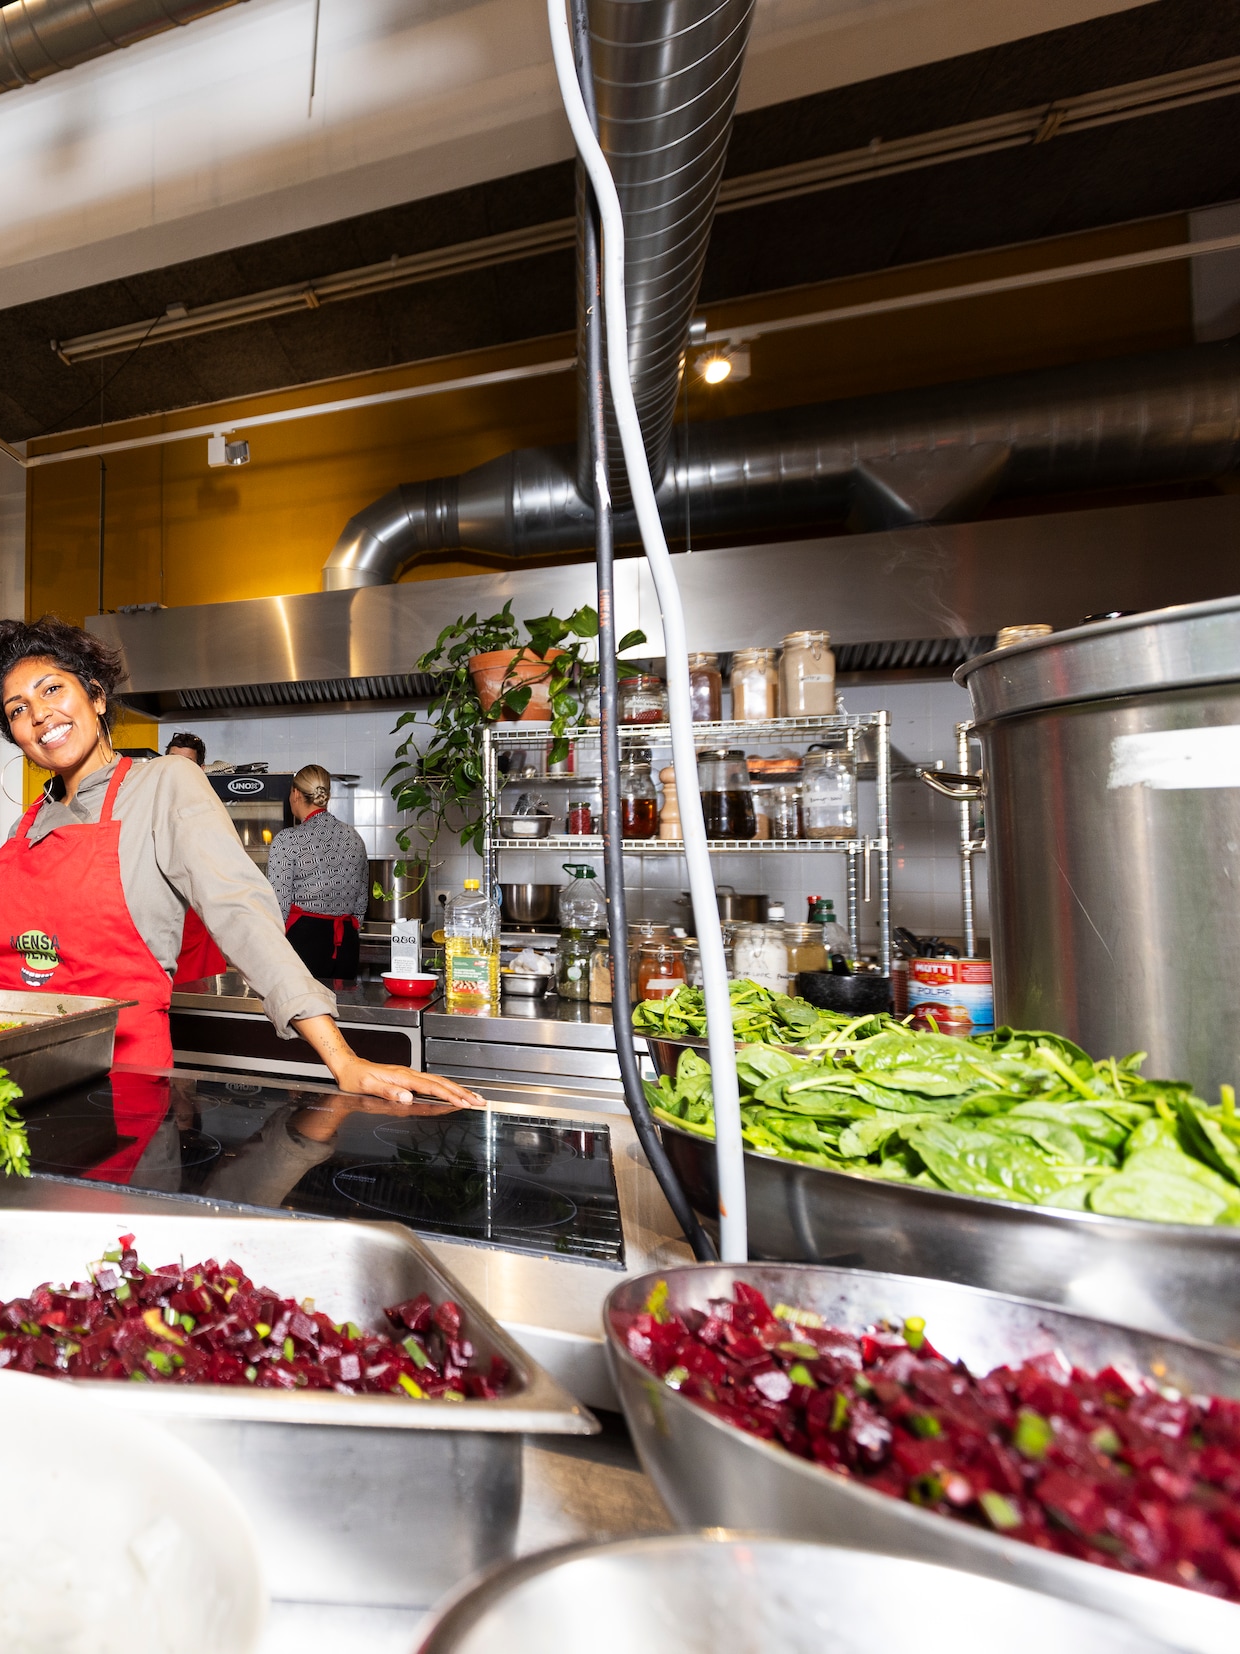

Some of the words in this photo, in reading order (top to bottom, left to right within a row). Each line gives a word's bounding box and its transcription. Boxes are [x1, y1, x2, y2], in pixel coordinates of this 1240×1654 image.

[231, 782, 259, 791] UNOX
[10, 934, 60, 951] MENSA
[392, 935, 416, 945] Q&Q
[915, 963, 954, 977] MUTTI
[918, 986, 953, 997] POLPA
